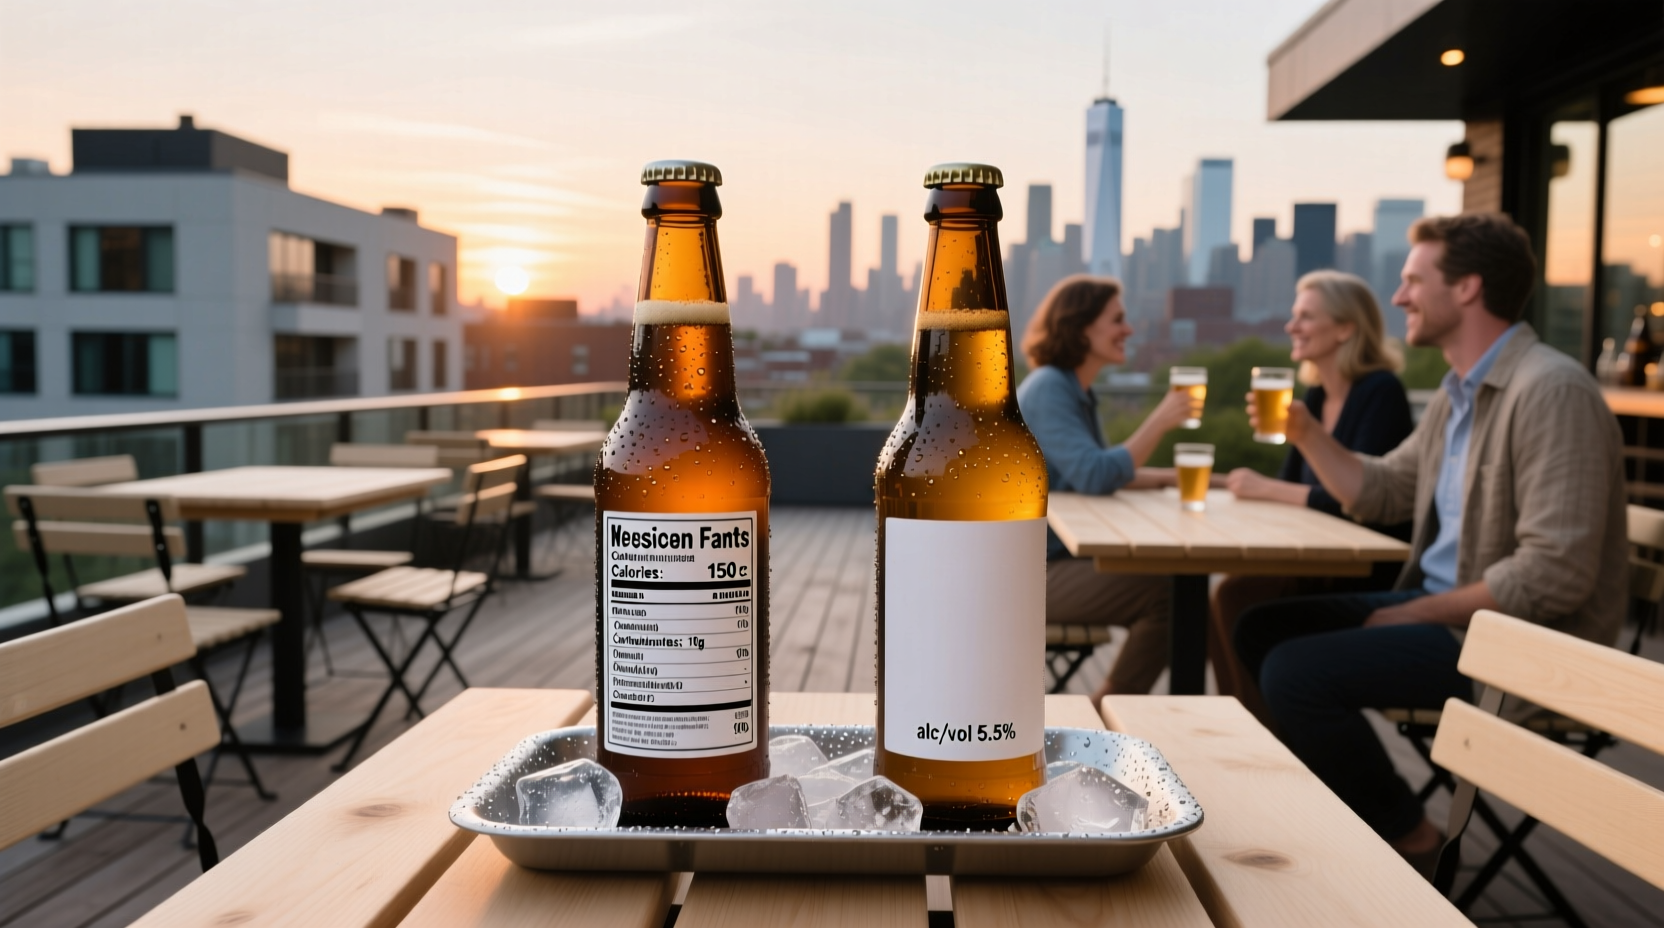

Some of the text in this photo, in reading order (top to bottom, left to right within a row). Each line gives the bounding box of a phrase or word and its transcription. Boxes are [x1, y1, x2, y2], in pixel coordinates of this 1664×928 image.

[700, 526, 750, 549] Fants
[707, 561, 737, 579] 150
[917, 722, 1016, 745] alc/vol 5.5%
